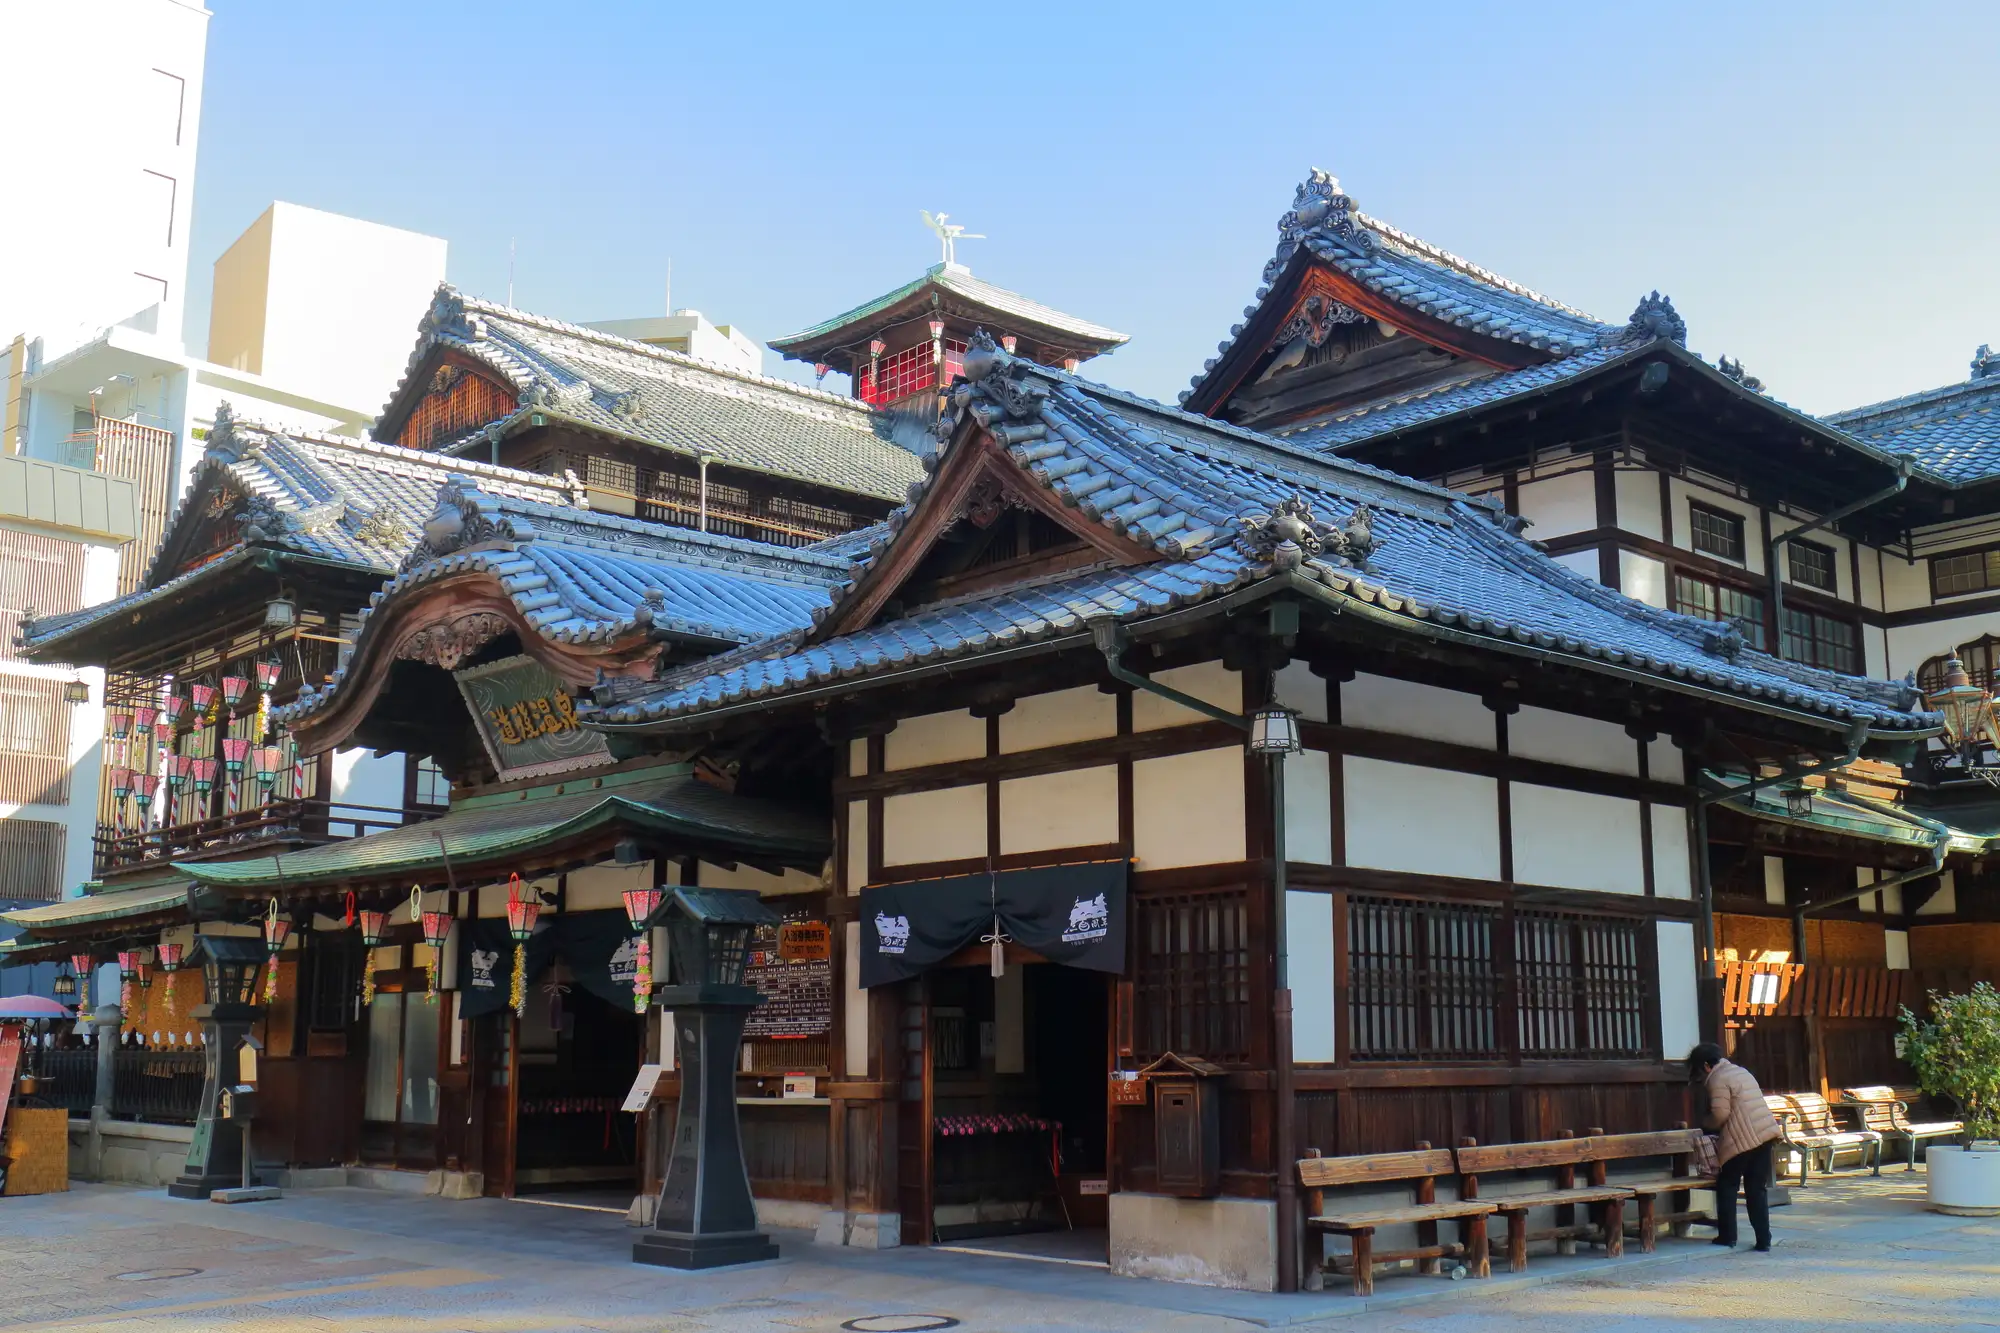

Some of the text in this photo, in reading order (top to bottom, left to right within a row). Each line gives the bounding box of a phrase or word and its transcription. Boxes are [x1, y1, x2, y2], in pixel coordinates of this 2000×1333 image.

[488, 688, 581, 745] 道後温泉
[786, 945, 804, 954] TICKET
